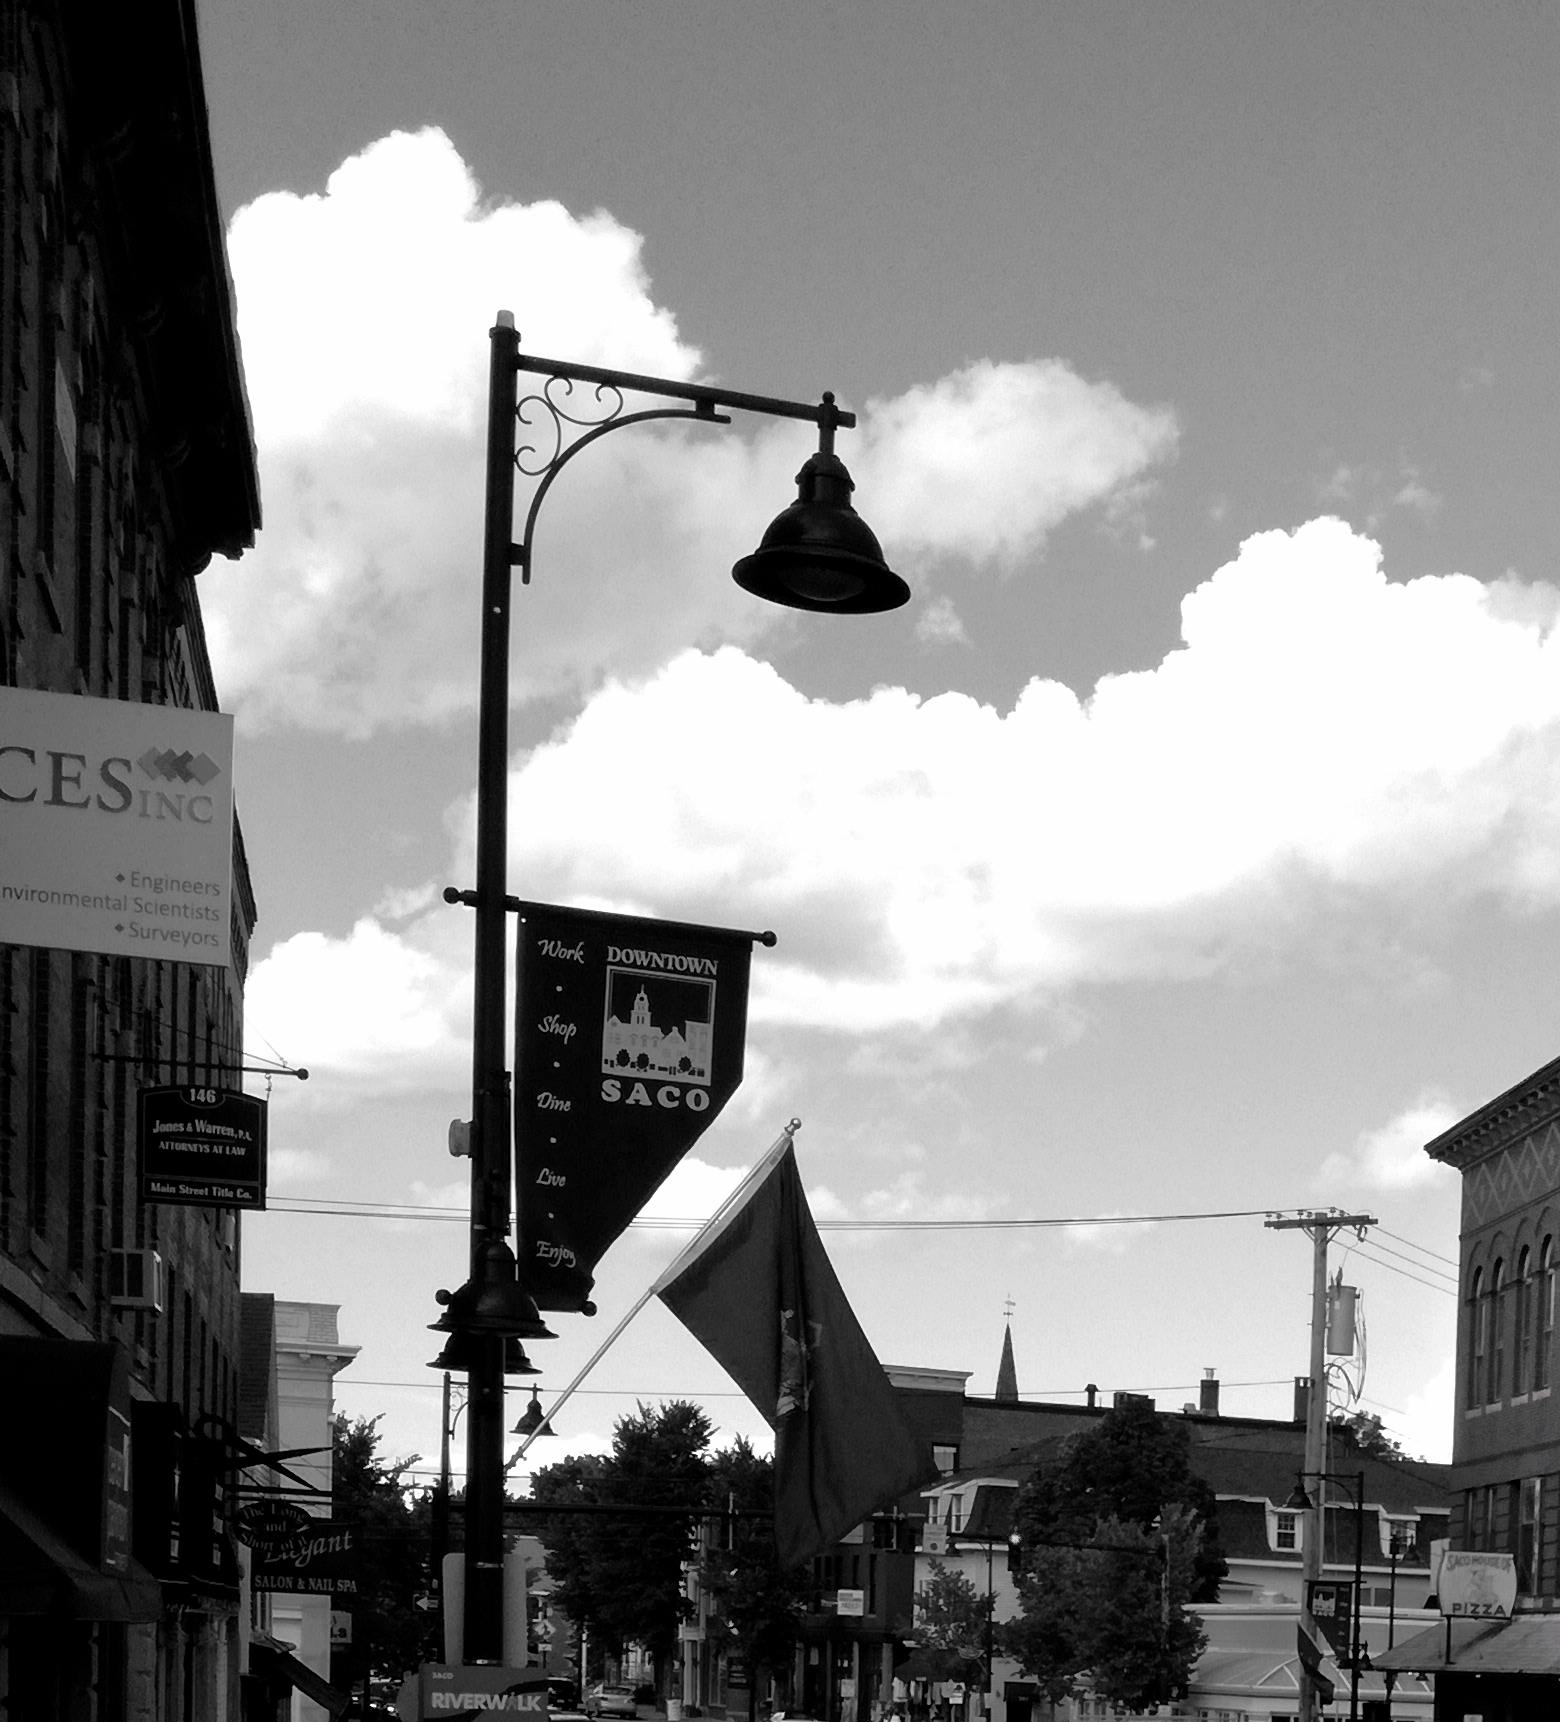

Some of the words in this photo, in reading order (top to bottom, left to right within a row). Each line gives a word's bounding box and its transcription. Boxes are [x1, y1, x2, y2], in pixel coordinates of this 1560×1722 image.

[0, 746, 133, 813] CES
[138, 790, 214, 823] INC
[131, 871, 221, 897] Engineers
[2, 884, 128, 911] nvironmental
[134, 897, 220, 922] Scientists
[129, 921, 219, 948] Surveyors
[537, 939, 585, 964] Work
[607, 945, 718, 976] DOWNTOWN
[537, 1015, 577, 1044] Shop
[189, 1088, 217, 1104] 146
[537, 1092, 571, 1112] Dine
[601, 1079, 710, 1112] SACO
[152, 1119, 184, 1134] Jones
[158, 1141, 210, 1154] ATTORNEYS
[212, 1145, 224, 1155] AT
[225, 1146, 246, 1156] LAW
[536, 1168, 566, 1188] Live
[150, 1182, 176, 1194] Main
[179, 1184, 209, 1196] Street
[211, 1186, 233, 1198] Title
[536, 1240, 576, 1268] Enjoy
[254, 1574, 293, 1590] SALON
[297, 1577, 305, 1590] &
[307, 1577, 334, 1592] NAIL
[336, 1579, 357, 1593] SPA
[1452, 1603, 1507, 1616] PIZZA
[431, 1691, 541, 1712] RIVERWALK
